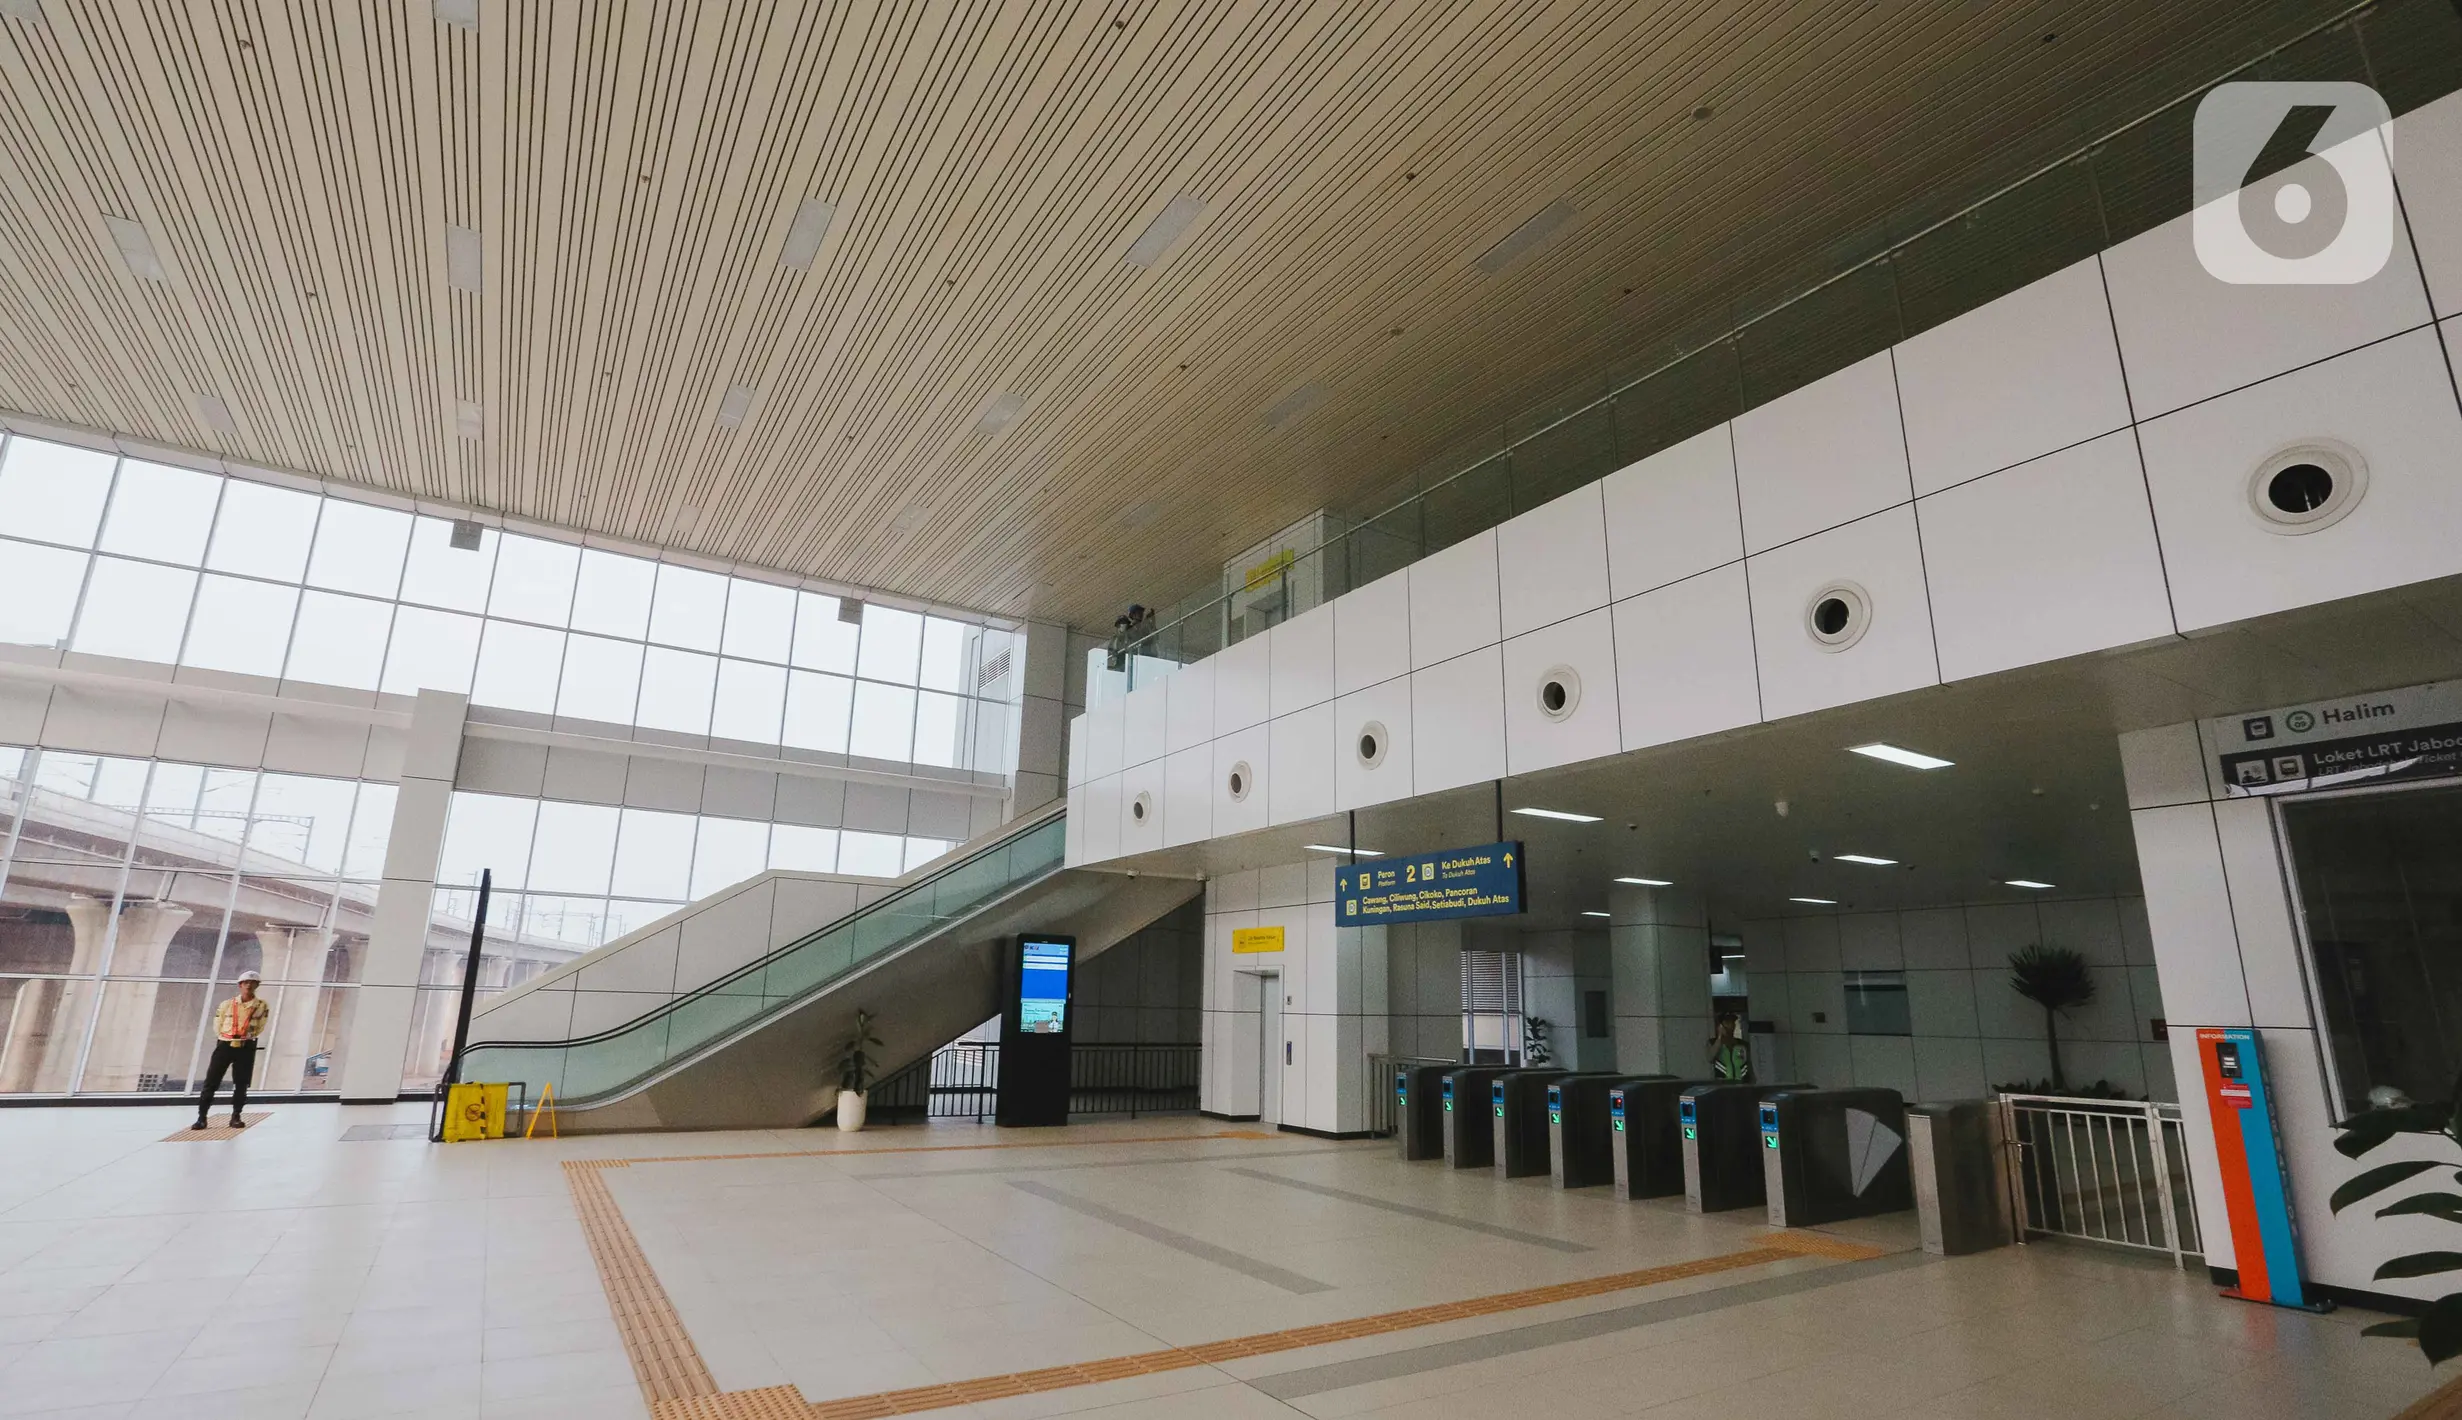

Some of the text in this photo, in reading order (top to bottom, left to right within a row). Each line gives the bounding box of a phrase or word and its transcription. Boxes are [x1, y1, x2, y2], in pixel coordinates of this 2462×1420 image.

[2322, 703, 2396, 725] Halim
[2313, 748, 2365, 765] Loket
[2367, 742, 2403, 758] LRT
[1441, 856, 1491, 869] Ke Dukuh Atas
[1407, 865, 1416, 883] 2
[1362, 887, 1478, 905] Cawang, Ciliwung, Cikoko, Pancoran
[1362, 905, 1392, 915] Kuningan,
[1393, 903, 1415, 912] Rasuna
[1467, 895, 1491, 906] Dukuh
[1492, 894, 1510, 904] Atas
